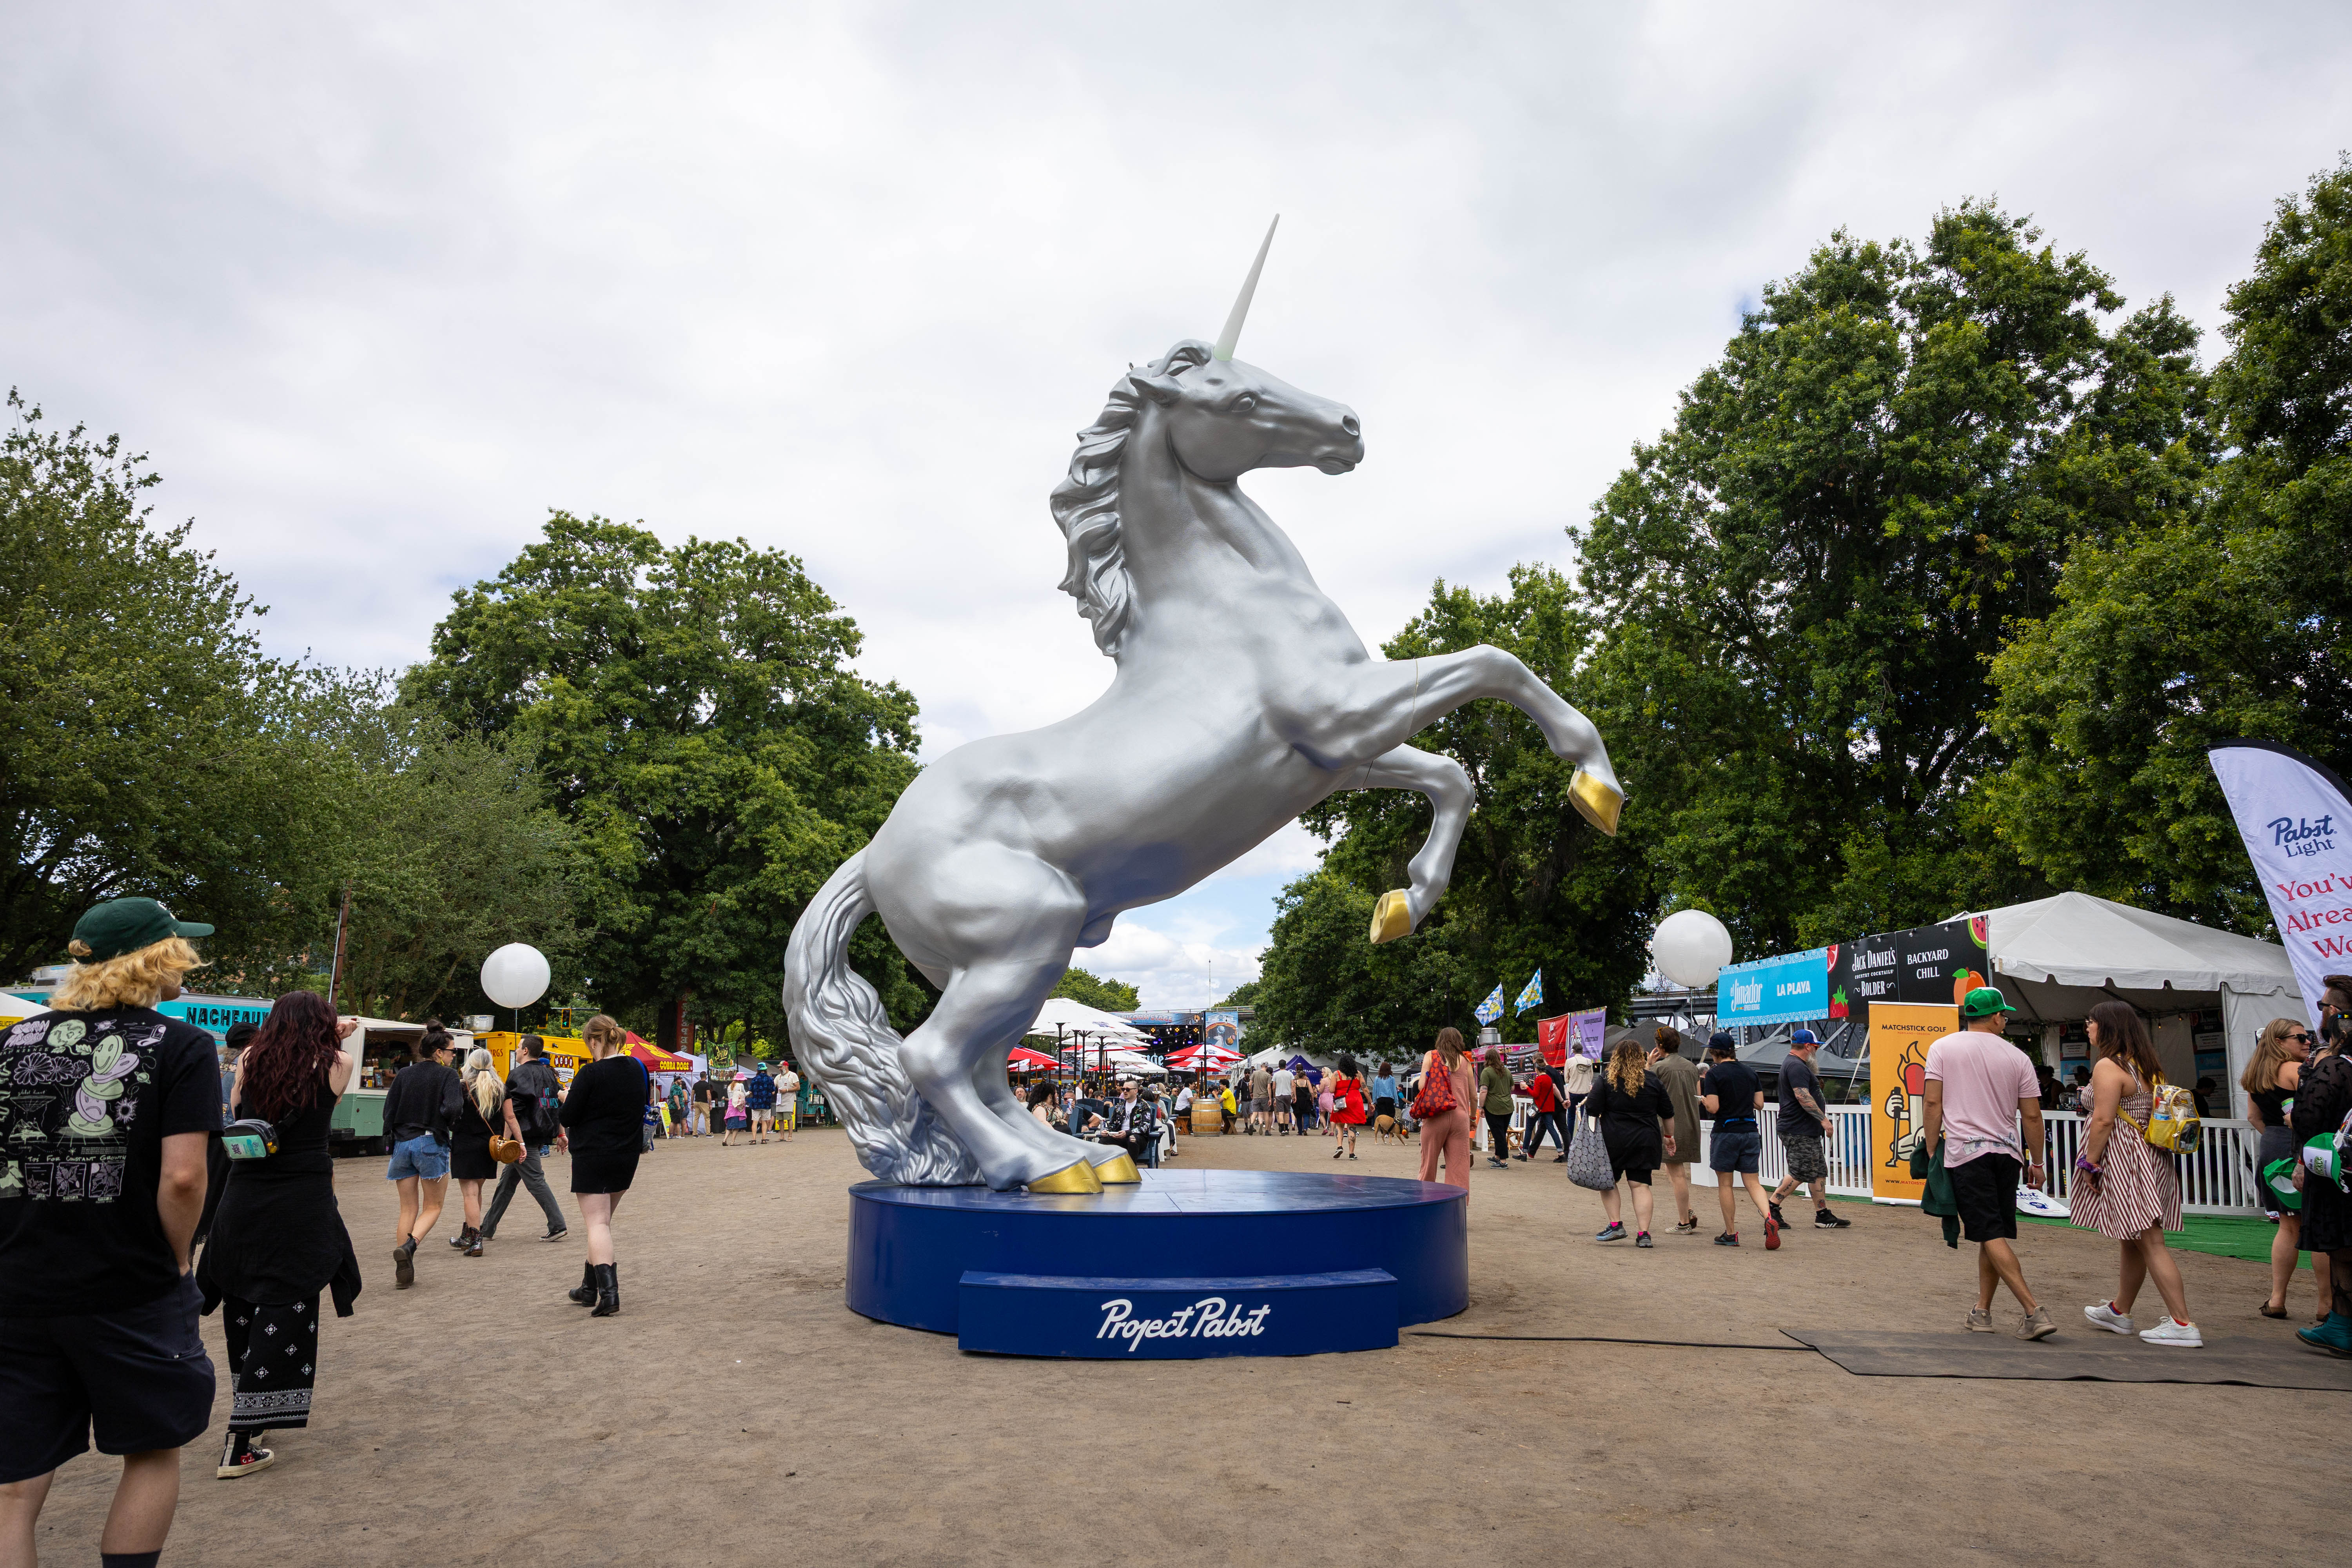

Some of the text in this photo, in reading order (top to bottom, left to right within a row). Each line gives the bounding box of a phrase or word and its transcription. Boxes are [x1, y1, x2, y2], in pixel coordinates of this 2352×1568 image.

[2267, 814, 2334, 846] Pabst
[2283, 839, 2335, 858] Light
[1852, 947, 1896, 971] JACK DANIEL'S
[1907, 949, 1949, 965] BACKYARD
[1916, 966, 1940, 979] CHILL
[1731, 976, 1762, 1012] Jimador
[1777, 981, 1811, 996] LA PLAYA
[1861, 981, 1886, 996] BOLDER
[660, 1061, 689, 1070] COBRA DOGS
[1097, 1297, 1271, 1351] Project Pabst
